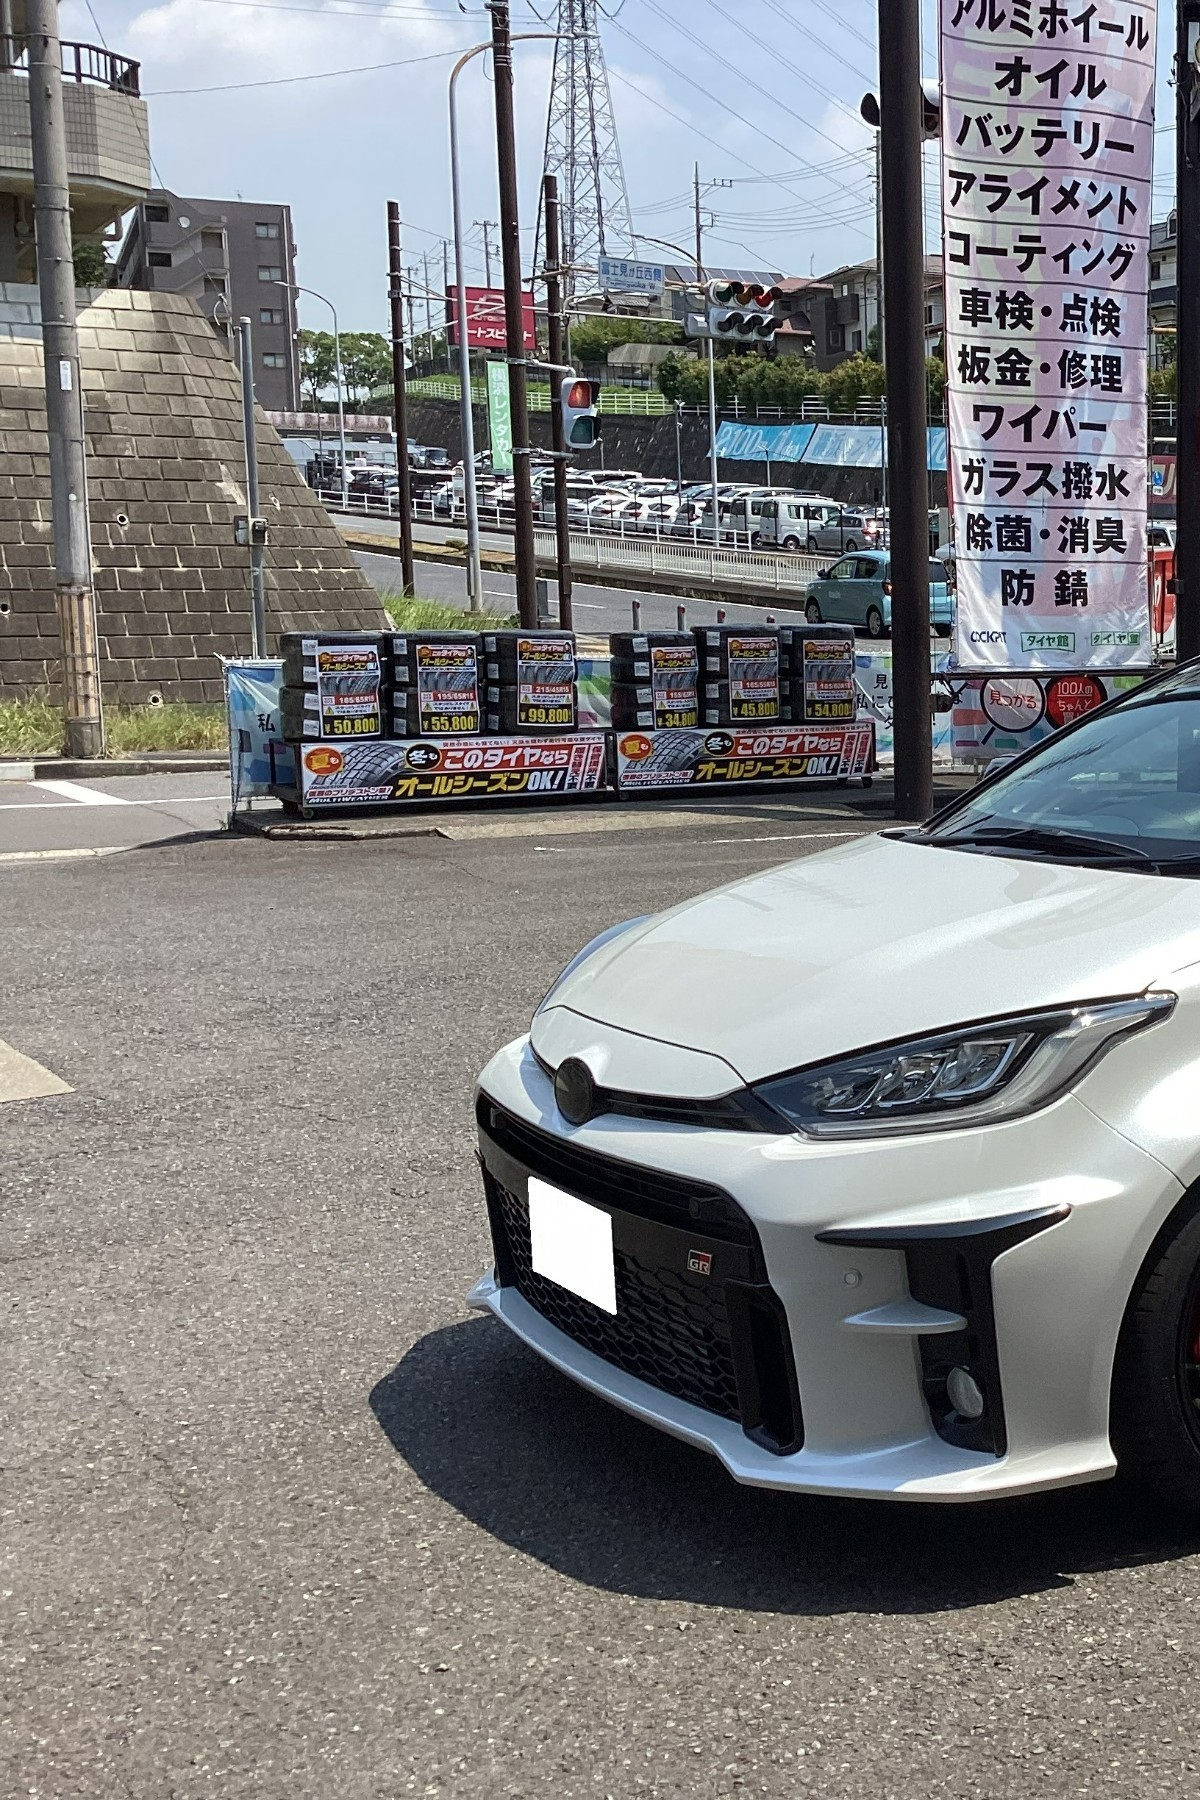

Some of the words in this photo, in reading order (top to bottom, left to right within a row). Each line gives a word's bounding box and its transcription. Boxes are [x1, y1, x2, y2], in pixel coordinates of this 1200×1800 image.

[953, 0, 1149, 51] アルミホイール
[995, 56, 1107, 99] オイル
[956, 111, 1135, 161] バッテリー
[949, 169, 1138, 225] アライメント
[949, 230, 1134, 281] コーティング
[958, 287, 1122, 337] 車検・点検
[956, 346, 1124, 394] 板金・修理
[972, 402, 1107, 443] ワイパー
[962, 457, 1130, 501] ガラス撥水
[966, 512, 1127, 556] 除菌・消臭
[1000, 569, 1089, 607] 防錆
[1026, 632, 1070, 647] タイヤ館
[989, 691, 1037, 709] 見つかる
[257, 713, 276, 732] 私
[406, 749, 438, 765] 冬も
[443, 747, 569, 770] このタイヤなら
[706, 737, 732, 751] 冬も
[736, 735, 842, 755] このタイヤなら
[395, 770, 566, 797] オールシーズンOK!
[696, 757, 839, 781] オールシーズンOK!
[689, 1259, 710, 1273] GR
